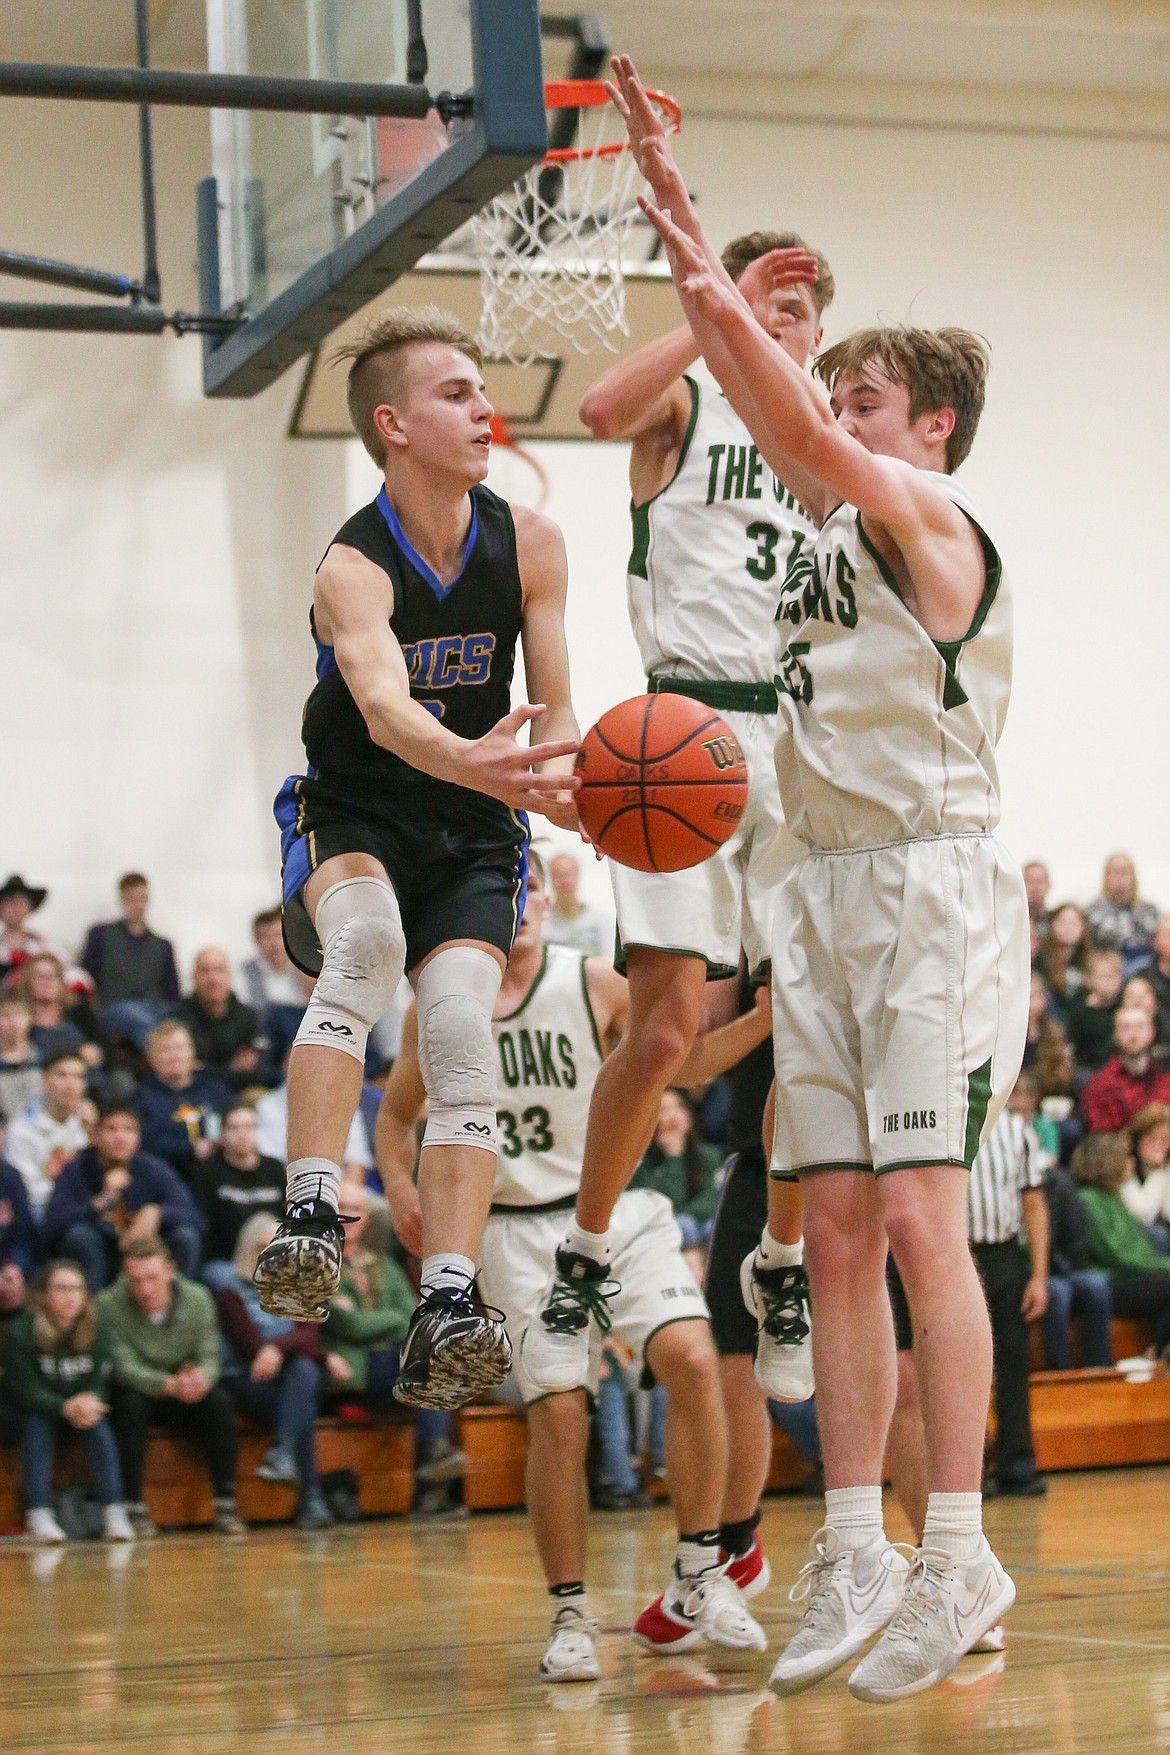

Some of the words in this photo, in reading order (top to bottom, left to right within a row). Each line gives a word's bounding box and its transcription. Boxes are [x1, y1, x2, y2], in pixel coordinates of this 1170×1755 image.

[706, 444, 763, 506] THE
[498, 1029, 577, 1089] OAKS
[496, 1105, 554, 1159] 33
[883, 1113, 899, 1134] THE
[903, 1110, 936, 1130] OAKS
